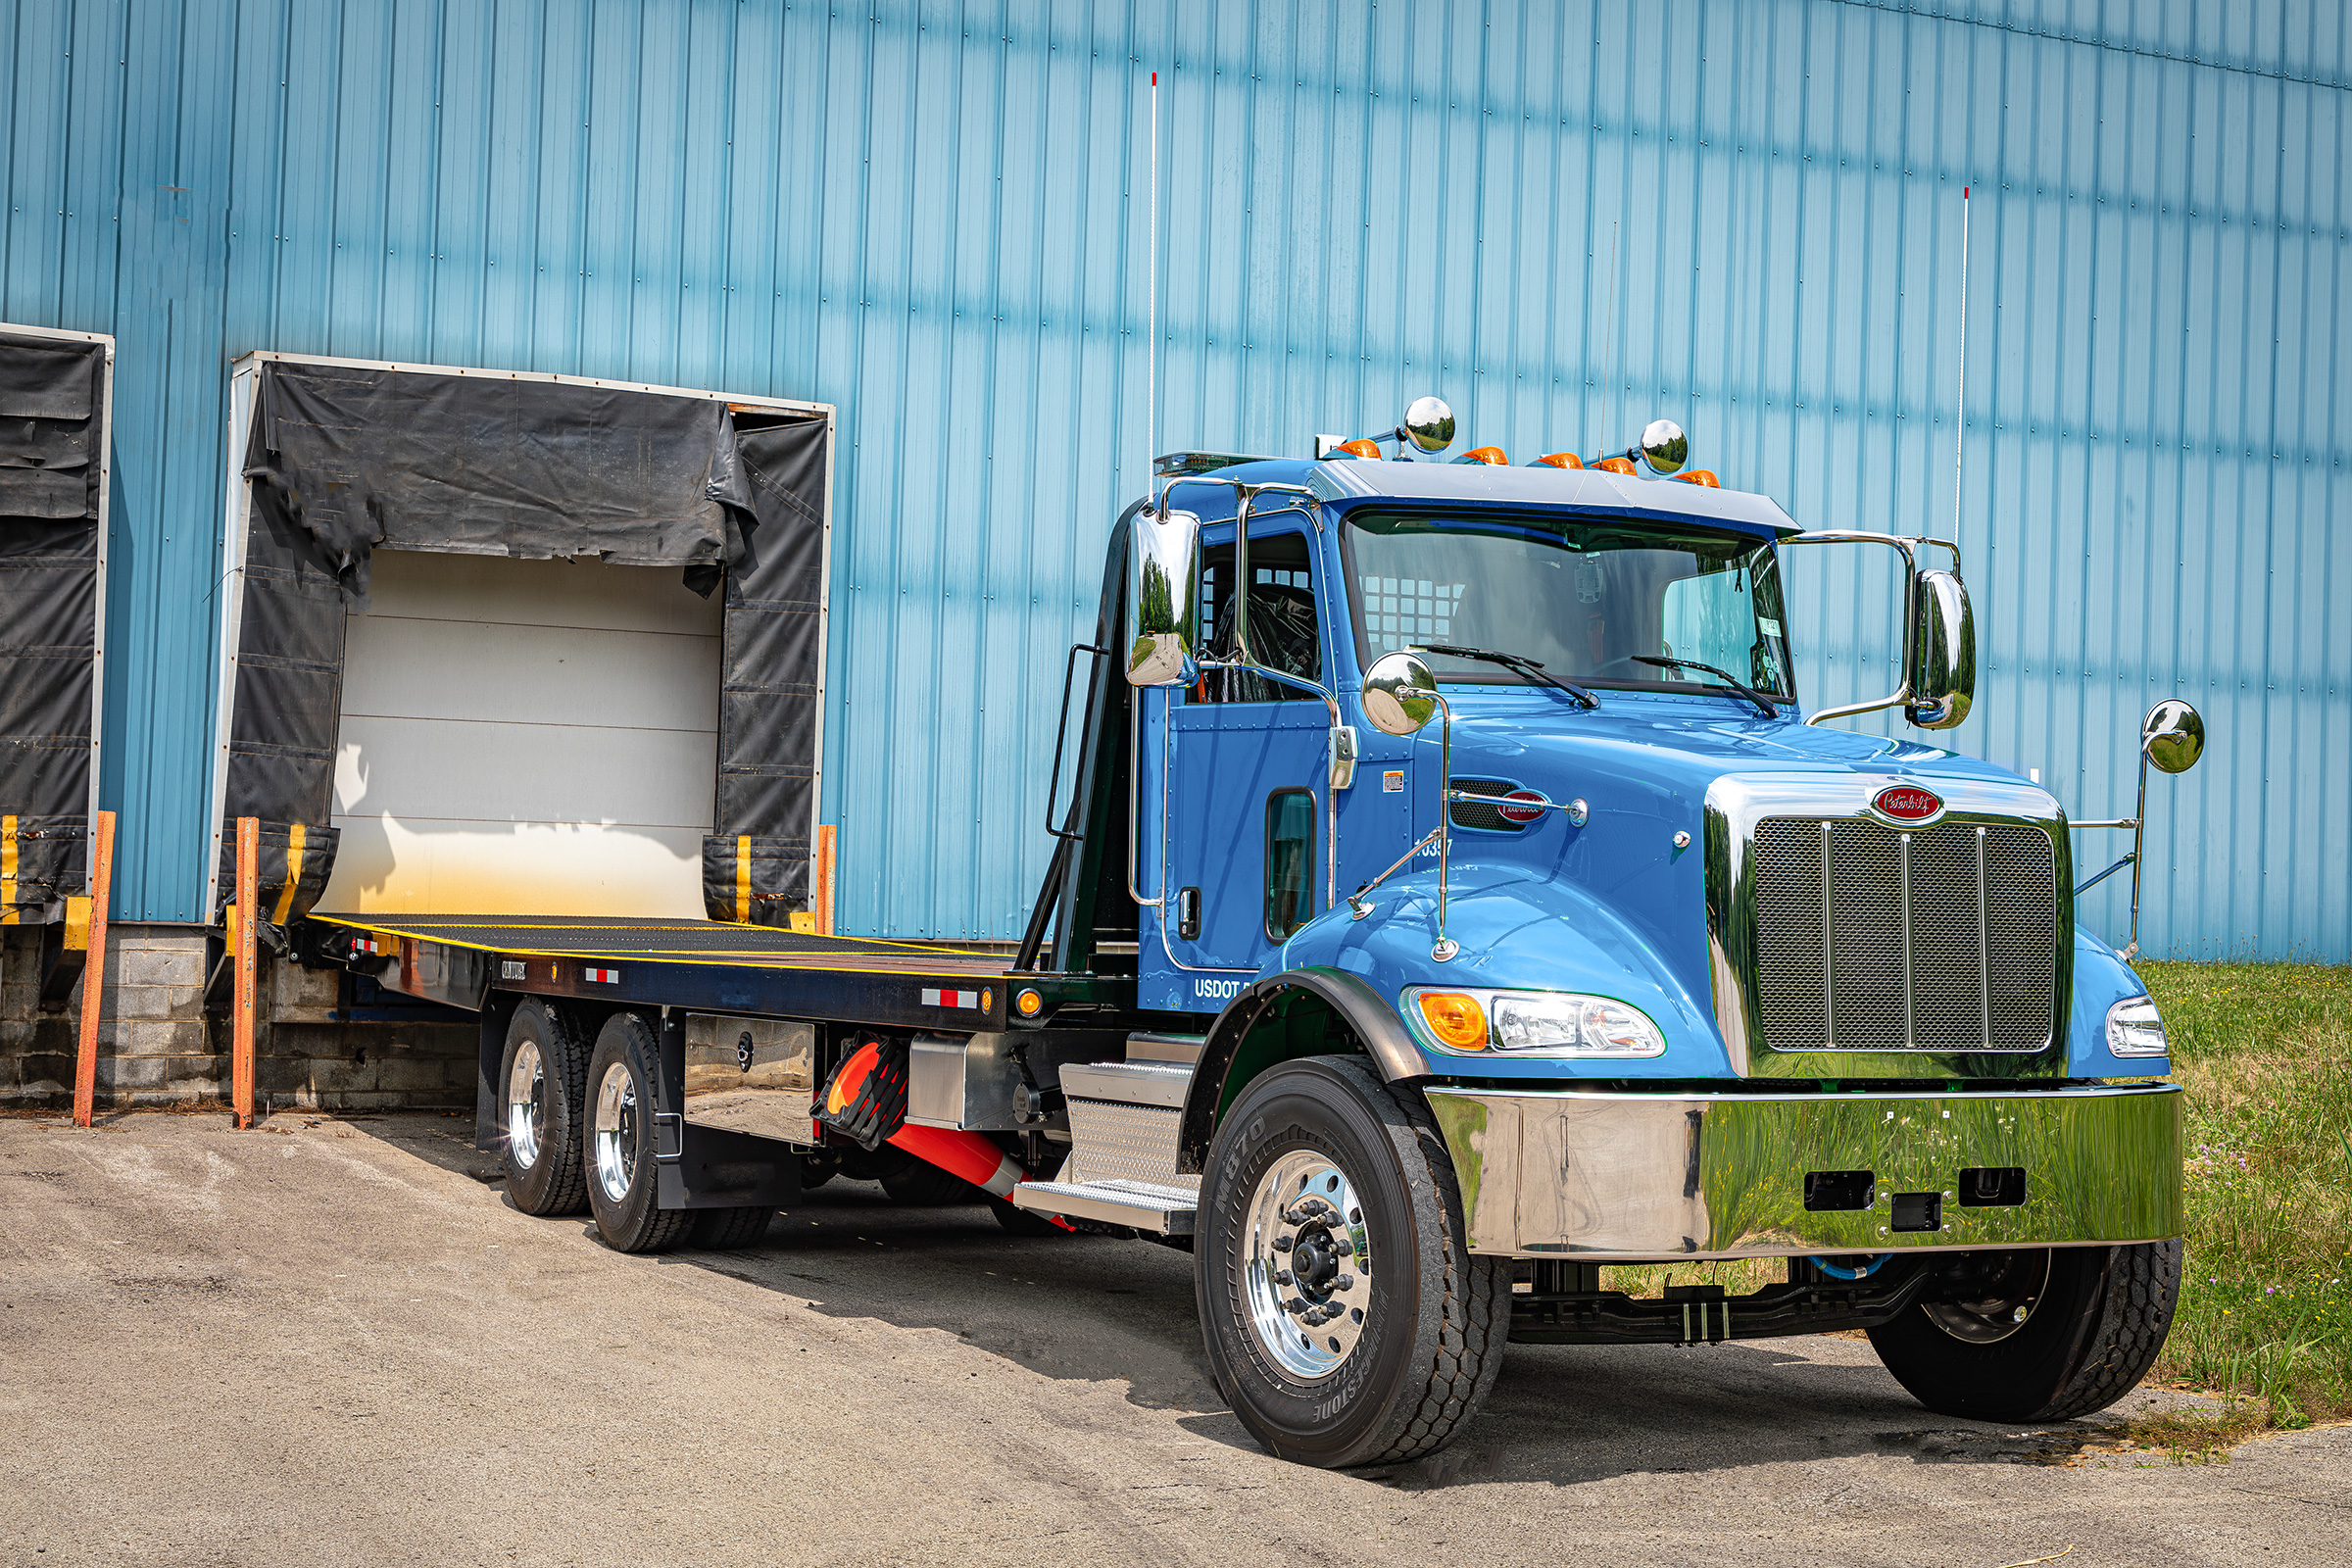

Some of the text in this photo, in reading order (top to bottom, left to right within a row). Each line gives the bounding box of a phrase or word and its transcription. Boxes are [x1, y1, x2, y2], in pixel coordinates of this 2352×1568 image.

[1885, 792, 1934, 815] Peterbilt
[1195, 978, 1241, 1000] USDOT
[1214, 1116, 1266, 1214] M870
[1312, 1285, 1390, 1424] BRIDGESTONE
